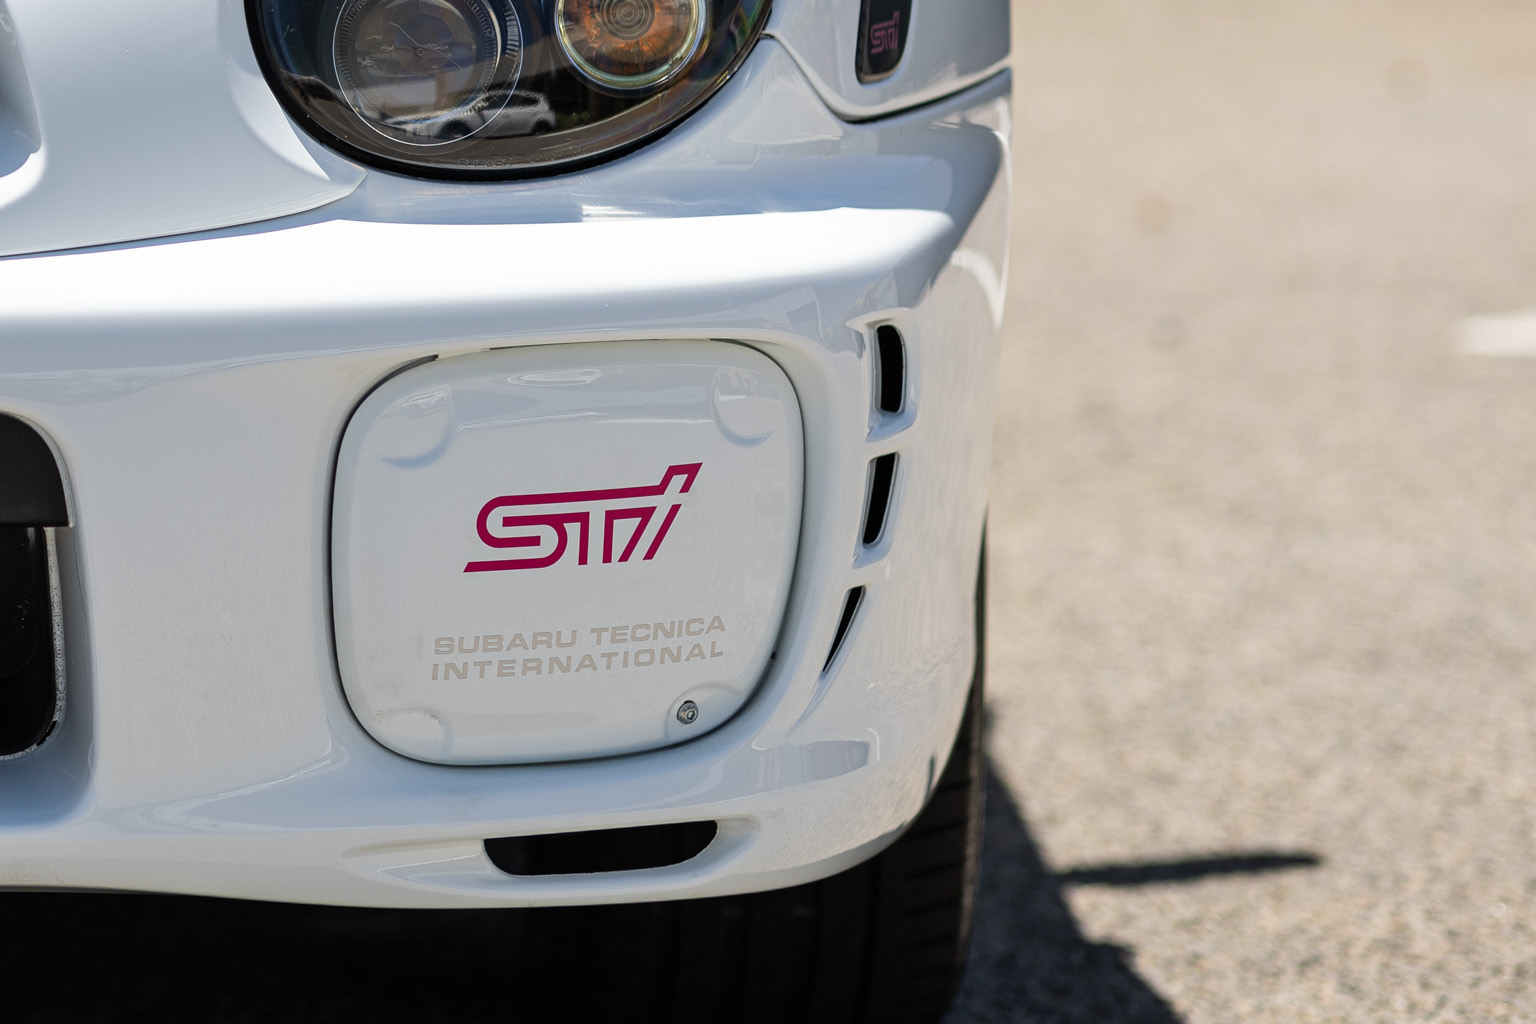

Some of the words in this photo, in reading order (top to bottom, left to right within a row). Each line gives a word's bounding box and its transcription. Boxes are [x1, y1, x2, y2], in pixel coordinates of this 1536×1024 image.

[434, 629, 577, 655] SUBARU
[590, 615, 726, 645] TECNICA
[431, 641, 723, 680] INTERNATIONAL
